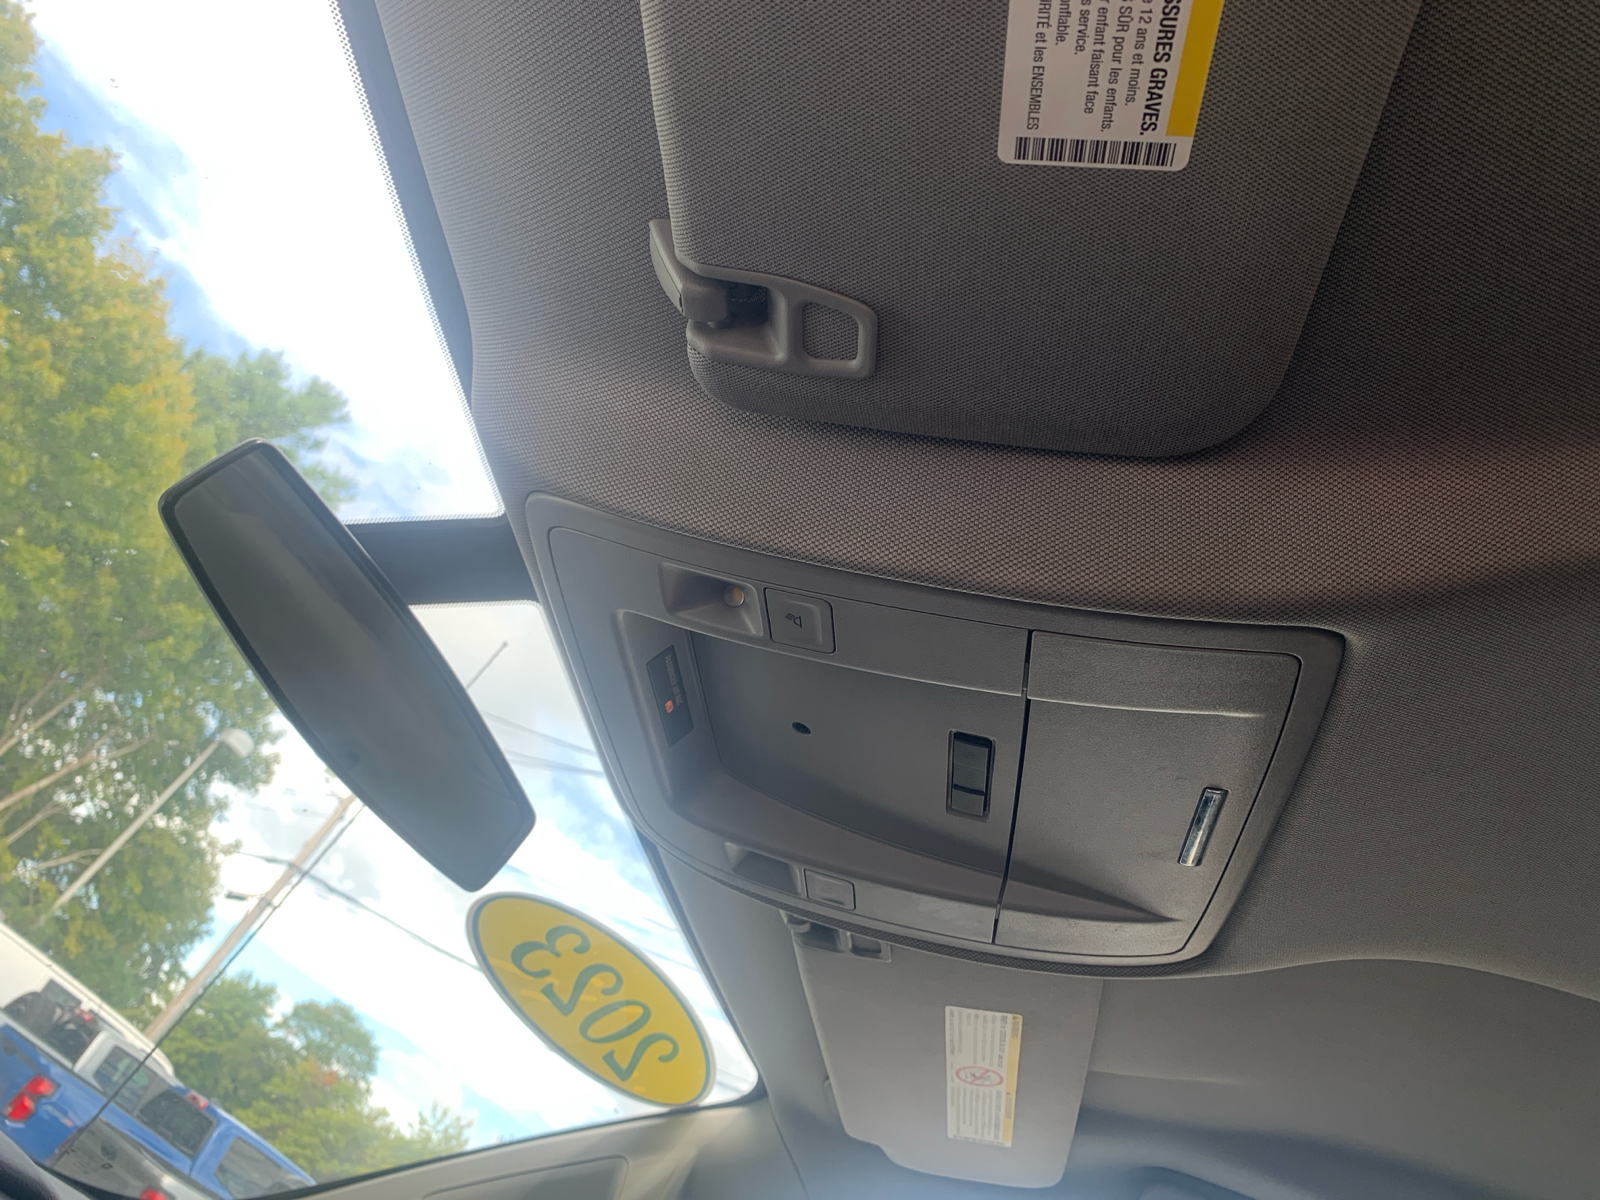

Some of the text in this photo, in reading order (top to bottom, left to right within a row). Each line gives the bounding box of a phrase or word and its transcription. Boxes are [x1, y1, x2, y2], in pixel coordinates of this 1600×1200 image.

[1093, 6, 1109, 47] enfant
[1116, 5, 1134, 33] SÛR
[1138, 8, 1154, 24] 12
[1034, 32, 1047, 44] et
[1074, 9, 1090, 55] service.
[1136, 27, 1148, 50] ans
[1033, 46, 1047, 63] les
[1111, 36, 1126, 64] pour
[1131, 52, 1144, 65] et
[1086, 48, 1106, 88] faisant
[1108, 66, 1123, 85] les
[1026, 65, 1046, 131] ENSEMBLES
[1125, 68, 1141, 106] moins.
[1084, 91, 1099, 115] face
[1100, 87, 1118, 133] enfants.
[1139, 68, 1169, 136] GRAVES.
